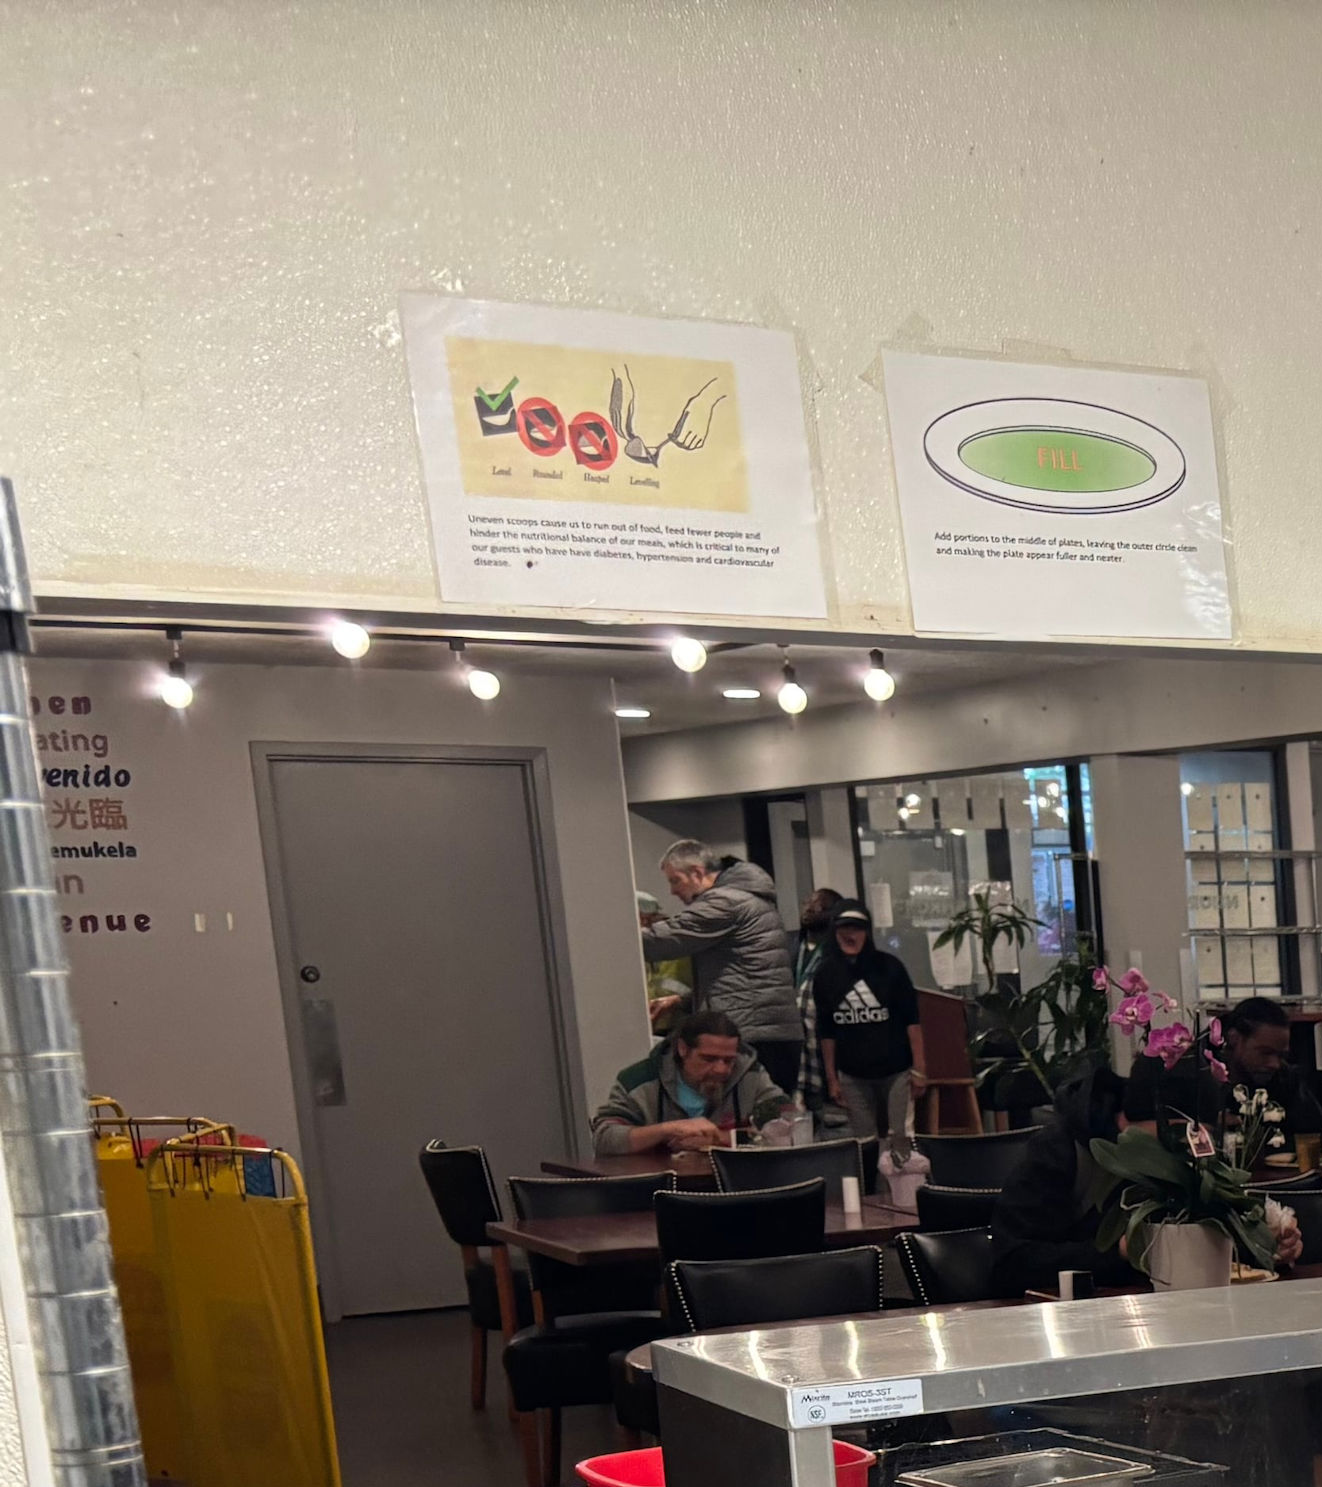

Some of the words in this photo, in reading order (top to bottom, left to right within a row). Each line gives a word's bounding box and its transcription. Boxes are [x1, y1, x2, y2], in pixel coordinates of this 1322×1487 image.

[1037, 446, 1084, 471] FILL
[468, 514, 504, 524] Uneven
[506, 518, 538, 527] scoops
[540, 520, 566, 528] cause
[569, 521, 580, 529] us
[581, 521, 592, 530] to
[593, 523, 609, 531] run
[611, 523, 627, 532] out
[628, 523, 638, 532] of
[640, 524, 663, 535] food,
[665, 526, 685, 535] feed
[687, 527, 711, 537] fewer
[714, 529, 743, 539] people
[745, 531, 761, 540] and
[469, 528, 501, 538] hinder
[502, 530, 518, 539] the
[520, 532, 569, 543] nutritional
[571, 533, 606, 544] balance
[608, 535, 618, 544] of
[620, 537, 635, 545] our
[637, 539, 665, 548] meals,
[668, 540, 694, 550] which
[695, 541, 703, 550] is
[704, 542, 733, 551] critical
[735, 543, 744, 552] to
[746, 546, 769, 555] many
[771, 545, 780, 554] of
[934, 531, 952, 541] Add
[953, 533, 989, 543] portions
[991, 535, 1001, 543] to
[1002, 535, 1017, 544] the
[1018, 536, 1047, 546] middle
[1048, 537, 1057, 546] of
[1059, 538, 1085, 548] plates,
[1086, 538, 1115, 550] leaving
[1117, 541, 1131, 550] the
[1131, 542, 1153, 550] outer
[1155, 542, 1176, 551] circle
[1177, 543, 1198, 552] clean
[471, 544, 488, 552] our
[490, 545, 521, 554] guests
[523, 545, 543, 555] who
[545, 547, 567, 556] have
[569, 548, 591, 557] have
[593, 549, 634, 560] diabetes,
[636, 551, 694, 563] hypertension
[695, 555, 712, 564] and
[714, 556, 774, 567] cardiovascular
[473, 557, 511, 568] disease.
[936, 547, 952, 555] and
[954, 547, 985, 558] making
[986, 548, 1001, 557] the
[1003, 549, 1024, 558] plate
[1026, 551, 1054, 560] appear
[1056, 551, 1077, 560] fuller
[1079, 553, 1094, 561] and
[49, 797, 128, 831] 光臨
